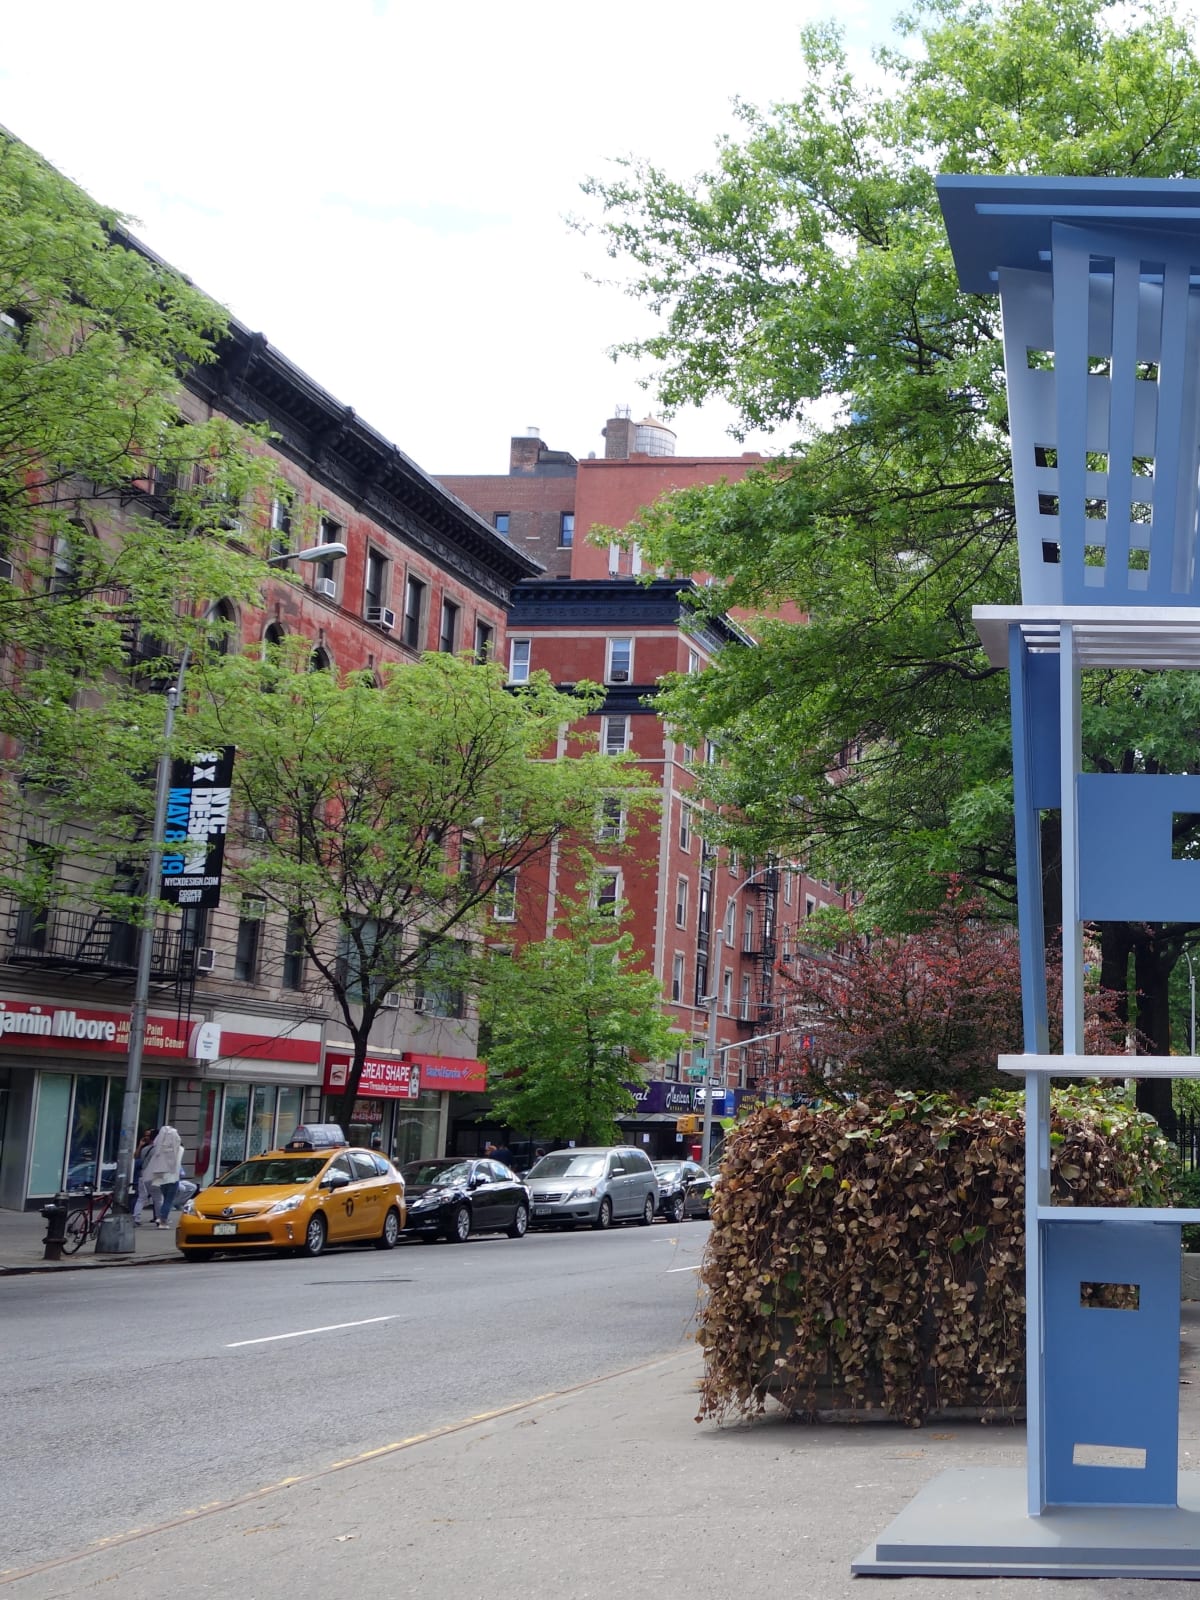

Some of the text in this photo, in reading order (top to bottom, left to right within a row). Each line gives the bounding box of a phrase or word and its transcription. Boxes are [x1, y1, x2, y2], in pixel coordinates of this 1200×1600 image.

[193, 766, 216, 782] X
[166, 788, 192, 826] MAY
[210, 788, 232, 834] NYC
[53, 1010, 115, 1041] Moore
[147, 1024, 163, 1036] Paint
[164, 1037, 185, 1049] Center
[361, 1062, 411, 1081] GREAT SHAPE
